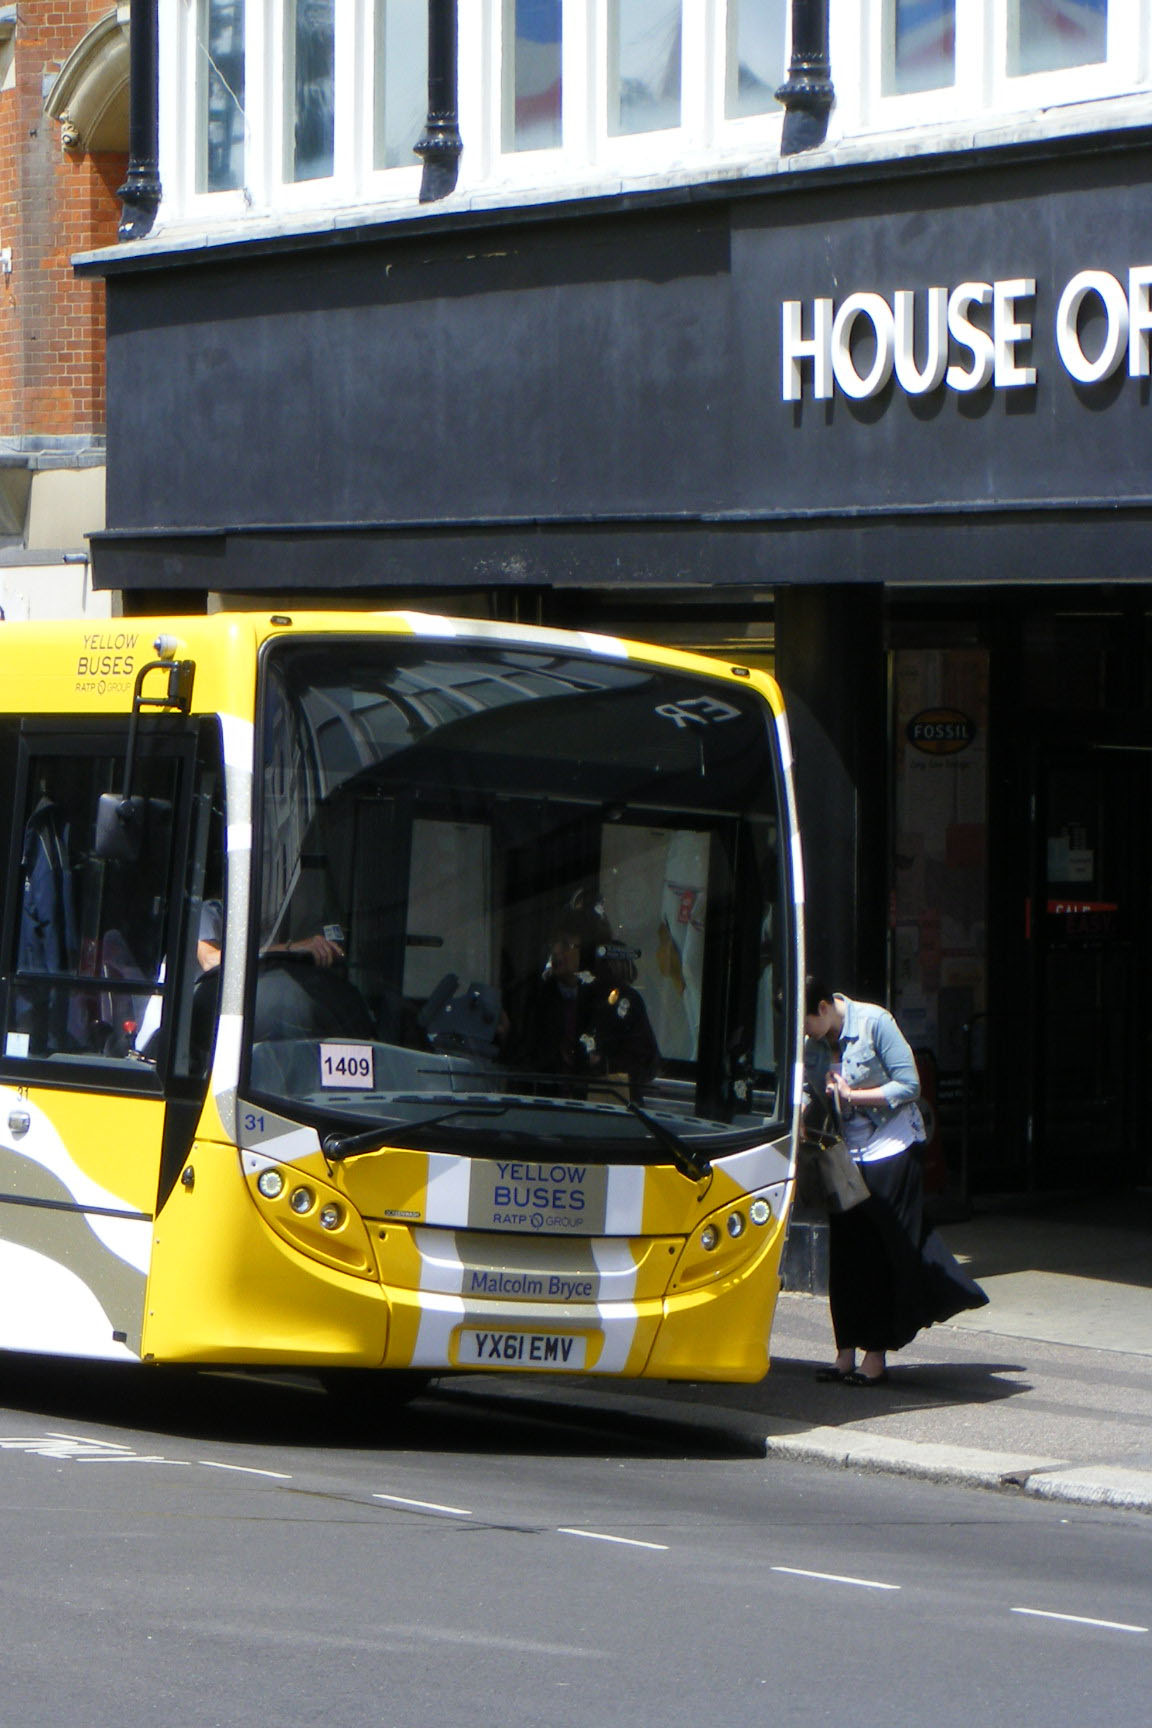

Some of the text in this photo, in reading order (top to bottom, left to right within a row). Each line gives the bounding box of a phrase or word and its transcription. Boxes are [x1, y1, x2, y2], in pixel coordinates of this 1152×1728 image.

[782, 278, 1037, 400] HOUSE
[84, 633, 139, 650] YELLOW
[77, 656, 134, 675] BUSES
[75, 681, 132, 693] RATP GROUP
[913, 724, 969, 740] FOSSIL
[323, 1056, 370, 1076] 1409
[16, 1085, 29, 1102] 31
[244, 1113, 265, 1133] 31
[496, 1162, 586, 1184] YELLOW
[494, 1186, 585, 1210] BUSES
[493, 1213, 584, 1228] RATP GROUP
[471, 1272, 592, 1300] Malcolm Bryce
[475, 1332, 573, 1362] YX61 EMV
